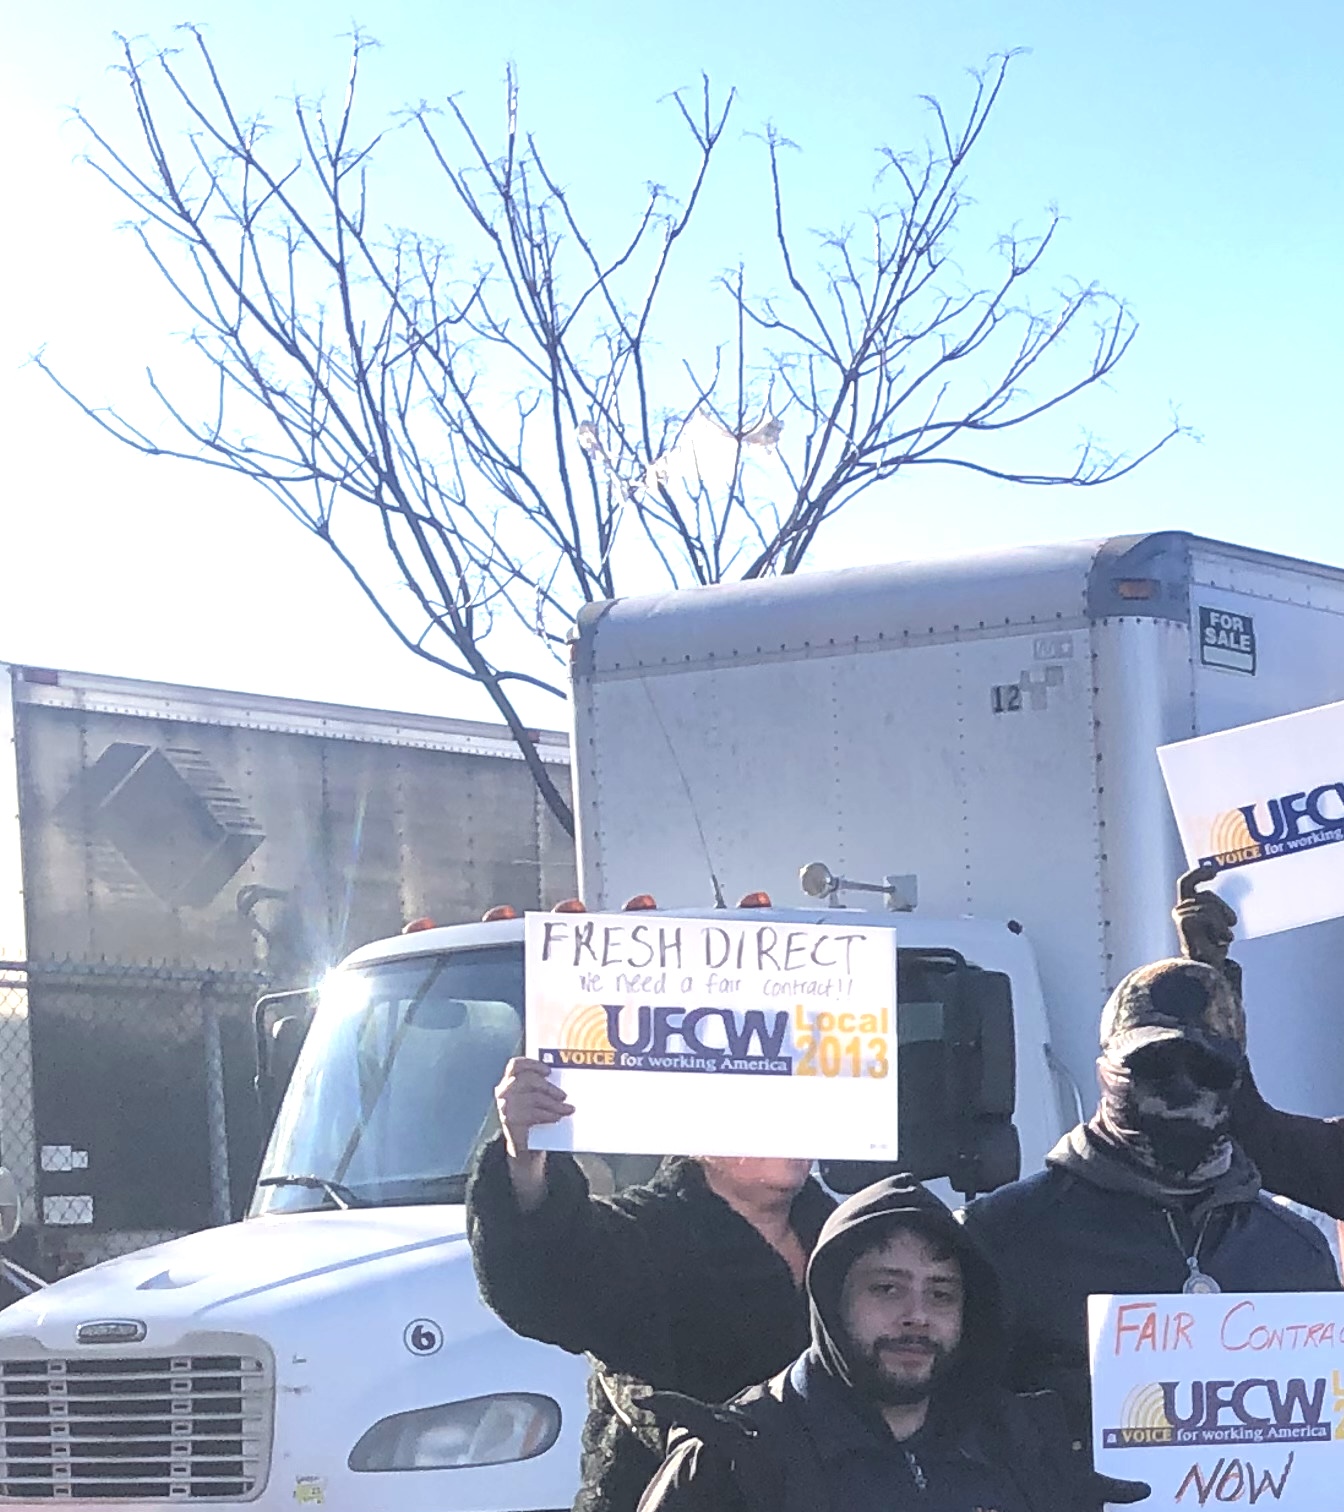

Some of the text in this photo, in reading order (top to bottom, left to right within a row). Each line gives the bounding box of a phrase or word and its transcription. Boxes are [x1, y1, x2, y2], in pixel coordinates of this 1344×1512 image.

[1210, 612, 1244, 632] FOR
[1205, 627, 1250, 652] SALE
[994, 685, 1020, 713] 12
[1215, 846, 1262, 866] VOICE
[1264, 843, 1283, 855] for
[1287, 828, 1344, 849] working
[542, 921, 867, 974] FRESH DIRECT
[616, 972, 666, 994] need
[681, 976, 693, 993] a
[706, 973, 741, 994] fair
[601, 1004, 789, 1058] UFCW
[795, 1004, 888, 1034] Local
[543, 1051, 787, 1073] a VOICE for working America
[795, 1035, 889, 1078] 2013
[411, 1325, 436, 1350] 6
[1115, 1302, 1197, 1356] FAIR
[1159, 1378, 1326, 1428] UFCW
[1106, 1425, 1327, 1443] a VOICE for working America
[1175, 1451, 1294, 1507] NOW
